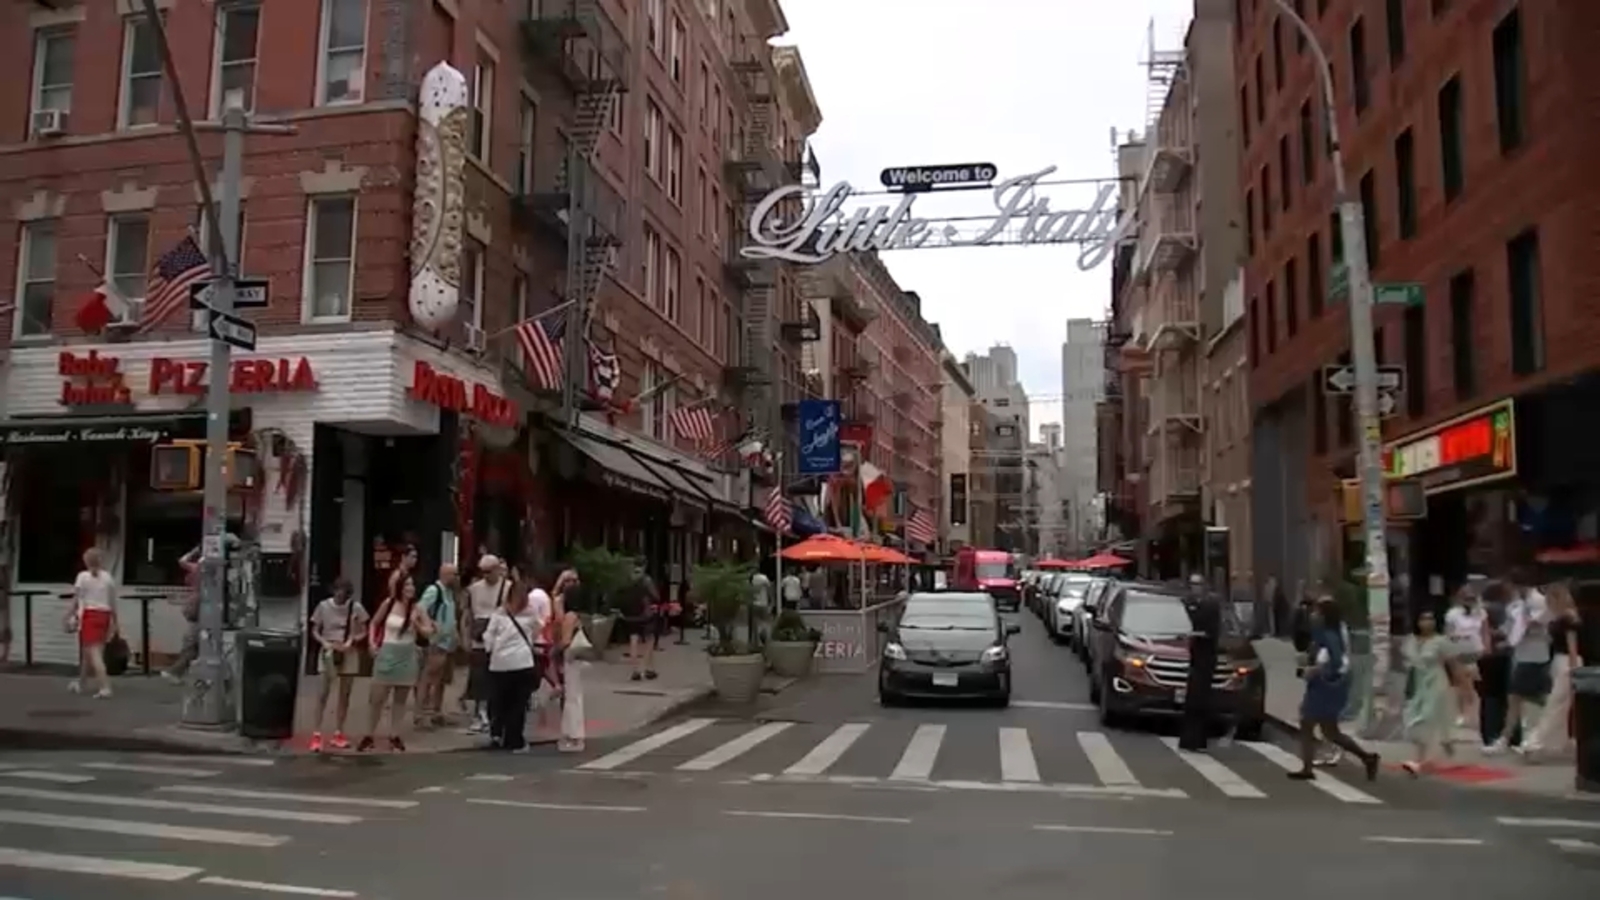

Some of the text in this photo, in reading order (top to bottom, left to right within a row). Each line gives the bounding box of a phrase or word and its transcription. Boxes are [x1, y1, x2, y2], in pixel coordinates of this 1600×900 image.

[889, 165, 993, 184] Welcome to
[740, 165, 1144, 271] Little Italy
[149, 356, 318, 394] PIZERIA
[813, 641, 862, 658] ZERIA
